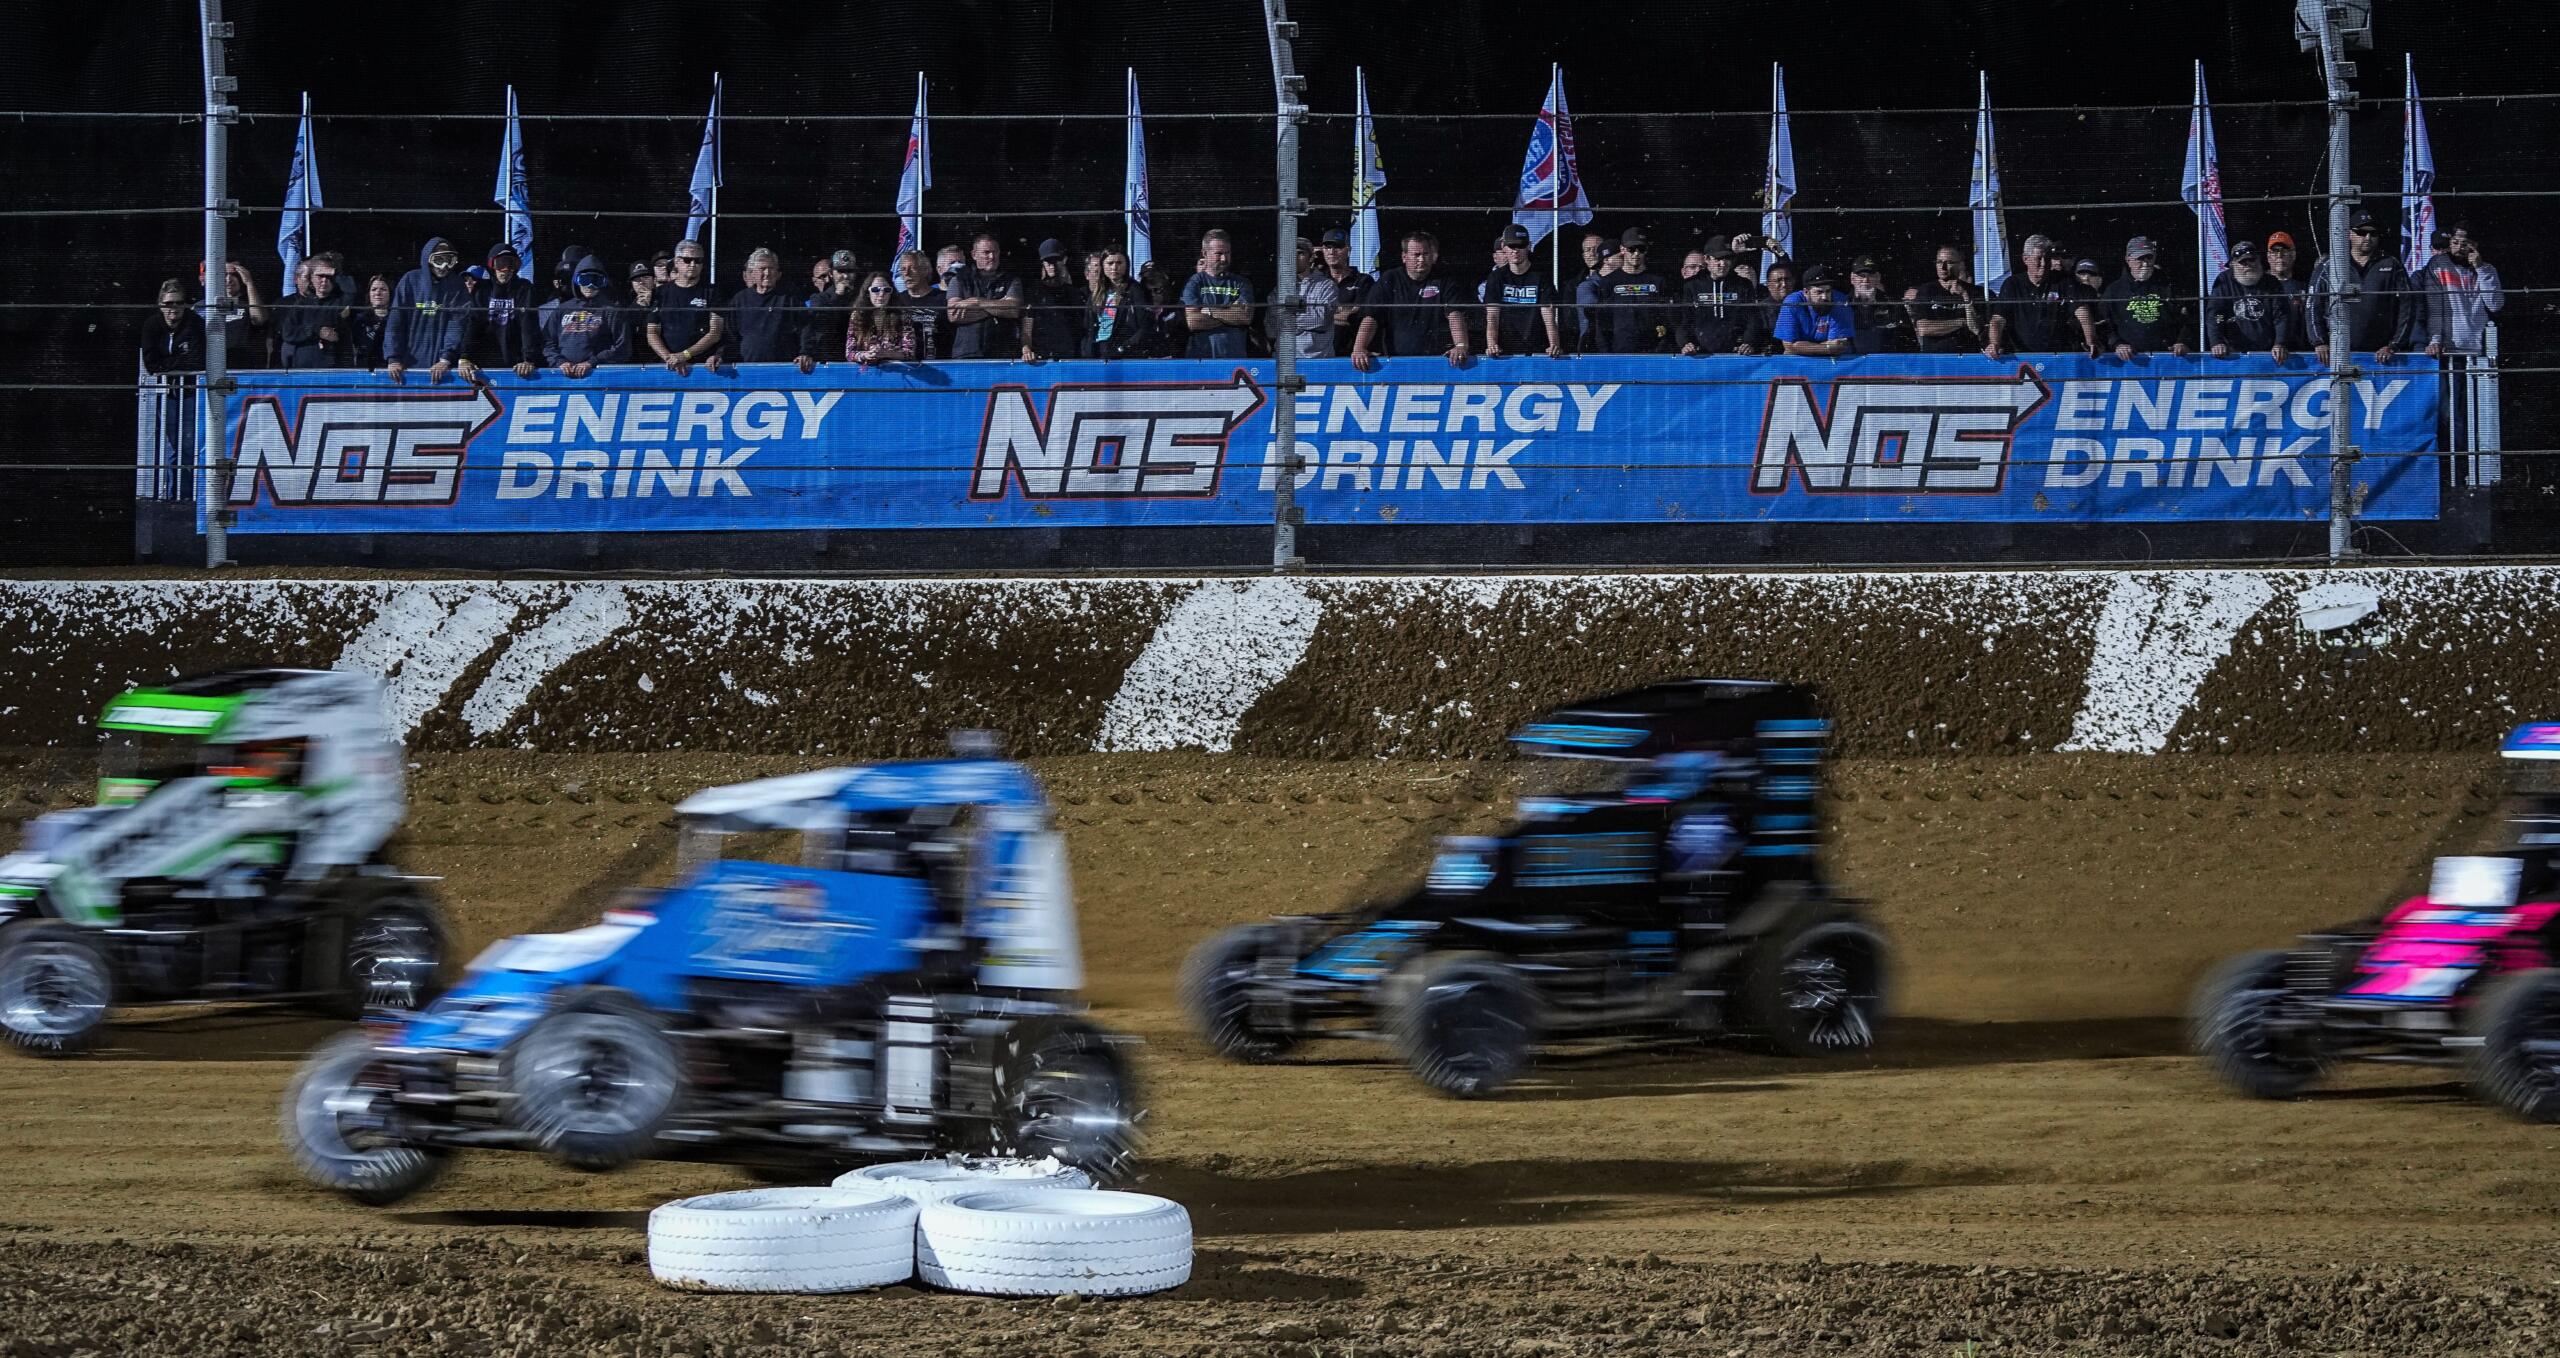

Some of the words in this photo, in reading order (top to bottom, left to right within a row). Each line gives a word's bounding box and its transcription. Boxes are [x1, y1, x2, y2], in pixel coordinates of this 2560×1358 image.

[506, 391, 844, 443] ENERGY
[1269, 384, 1621, 434] ENERGY
[1749, 363, 2051, 496] NOS
[2054, 379, 2411, 431] ENERGY
[227, 384, 504, 507] NOS
[969, 367, 1267, 499] NOS
[495, 448, 759, 499] DRINK
[1257, 439, 1533, 491] DRINK
[2044, 437, 2322, 488] DRINK
